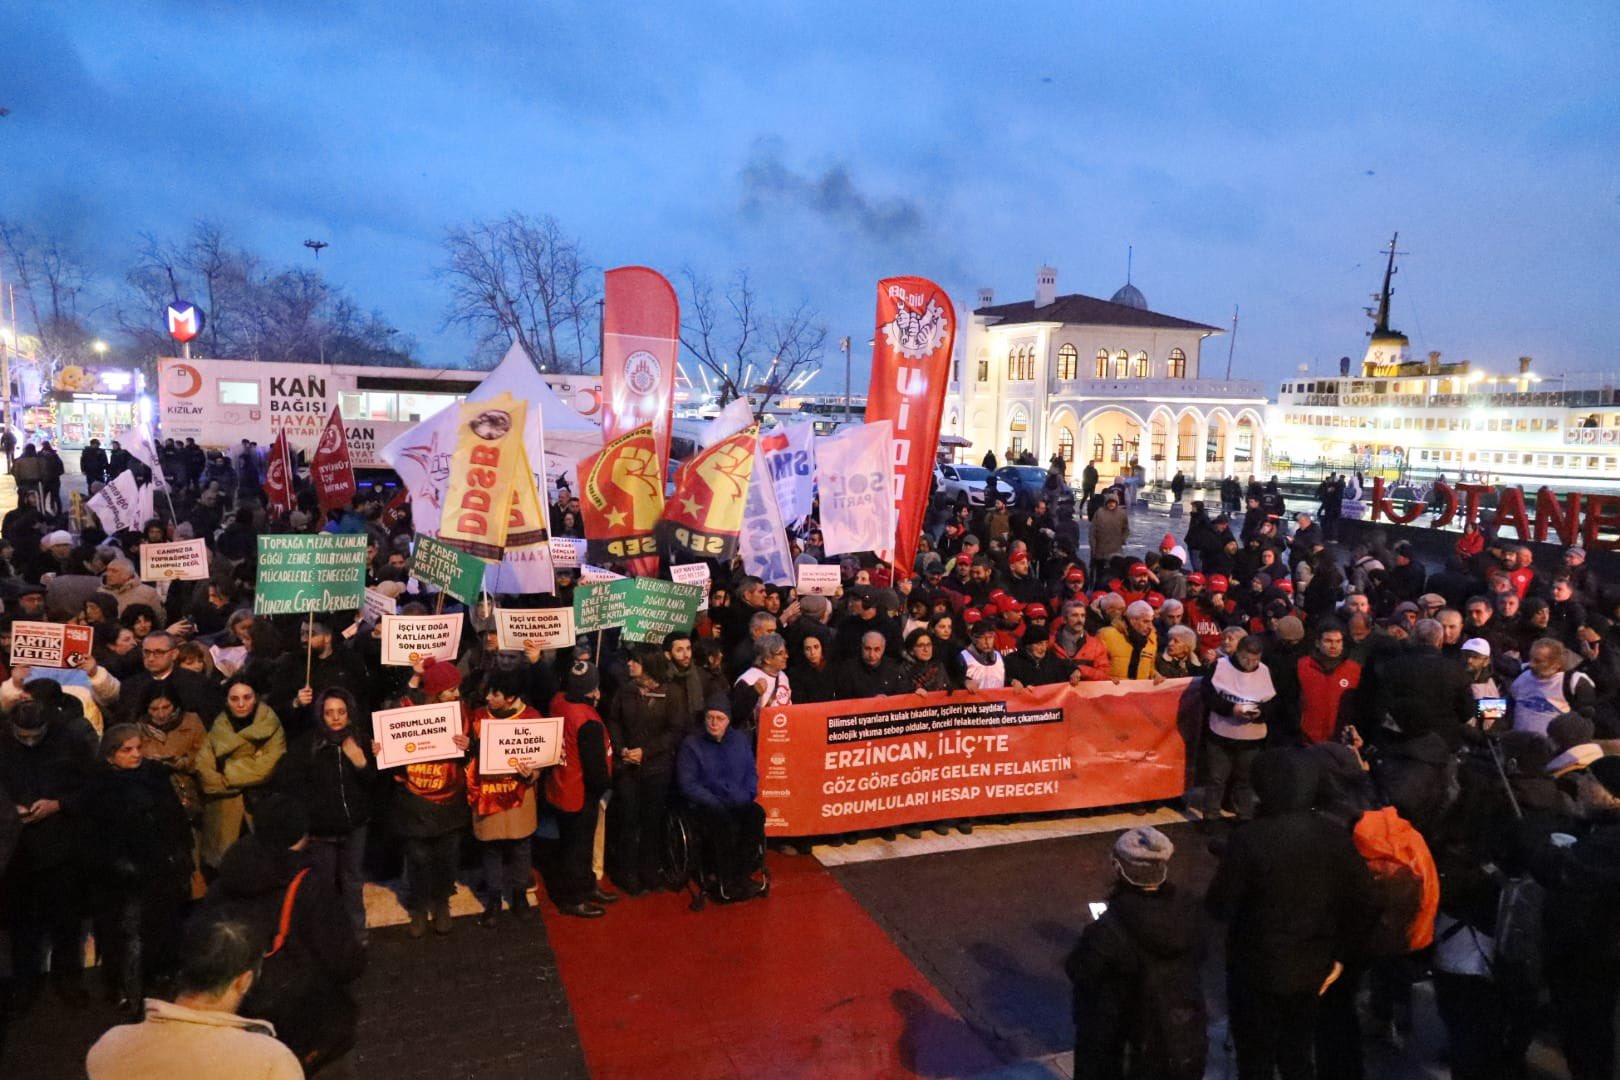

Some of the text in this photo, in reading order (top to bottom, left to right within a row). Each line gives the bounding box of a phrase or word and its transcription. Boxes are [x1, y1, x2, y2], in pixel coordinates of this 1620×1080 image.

[270, 377, 326, 398] KAN
[168, 406, 204, 414] KIZILAY
[270, 398, 326, 414] BAĞIŞI
[271, 415, 326, 426] HAYAT
[306, 537, 334, 549] MEZAR
[416, 550, 428, 561] NE
[418, 538, 430, 550] NE
[430, 544, 458, 564] KADER
[510, 614, 525, 622] İŞÇİ
[398, 622, 414, 632] İŞÇİ
[427, 623, 449, 631] DOĞA
[15, 635, 60, 649] ARTIK
[396, 632, 450, 640] KATLİAMLARI
[416, 641, 447, 650] BULSUN
[14, 648, 60, 660] YETER
[828, 717, 858, 728] Bilimsel
[890, 711, 910, 722] kulak
[963, 704, 977, 714] yok
[389, 716, 446, 730] SORUMLULAR
[828, 731, 858, 742] ekolojik
[883, 725, 905, 736] sebep
[905, 722, 931, 732] oldular,
[953, 716, 1000, 727] felaketlerden
[1001, 714, 1017, 724] ders
[390, 726, 447, 740] YARGILANSIN
[523, 736, 546, 744] DEĞİL
[504, 746, 540, 755] KATLİAM
[824, 742, 934, 770] ERZİNCAN,
[406, 763, 442, 775] EMEK
[822, 754, 1072, 795] GÖZ GÖRE GÖRE GELEN FELAKETİN
[822, 780, 1060, 818] SORUMLULARI HESAP VERECEK!
